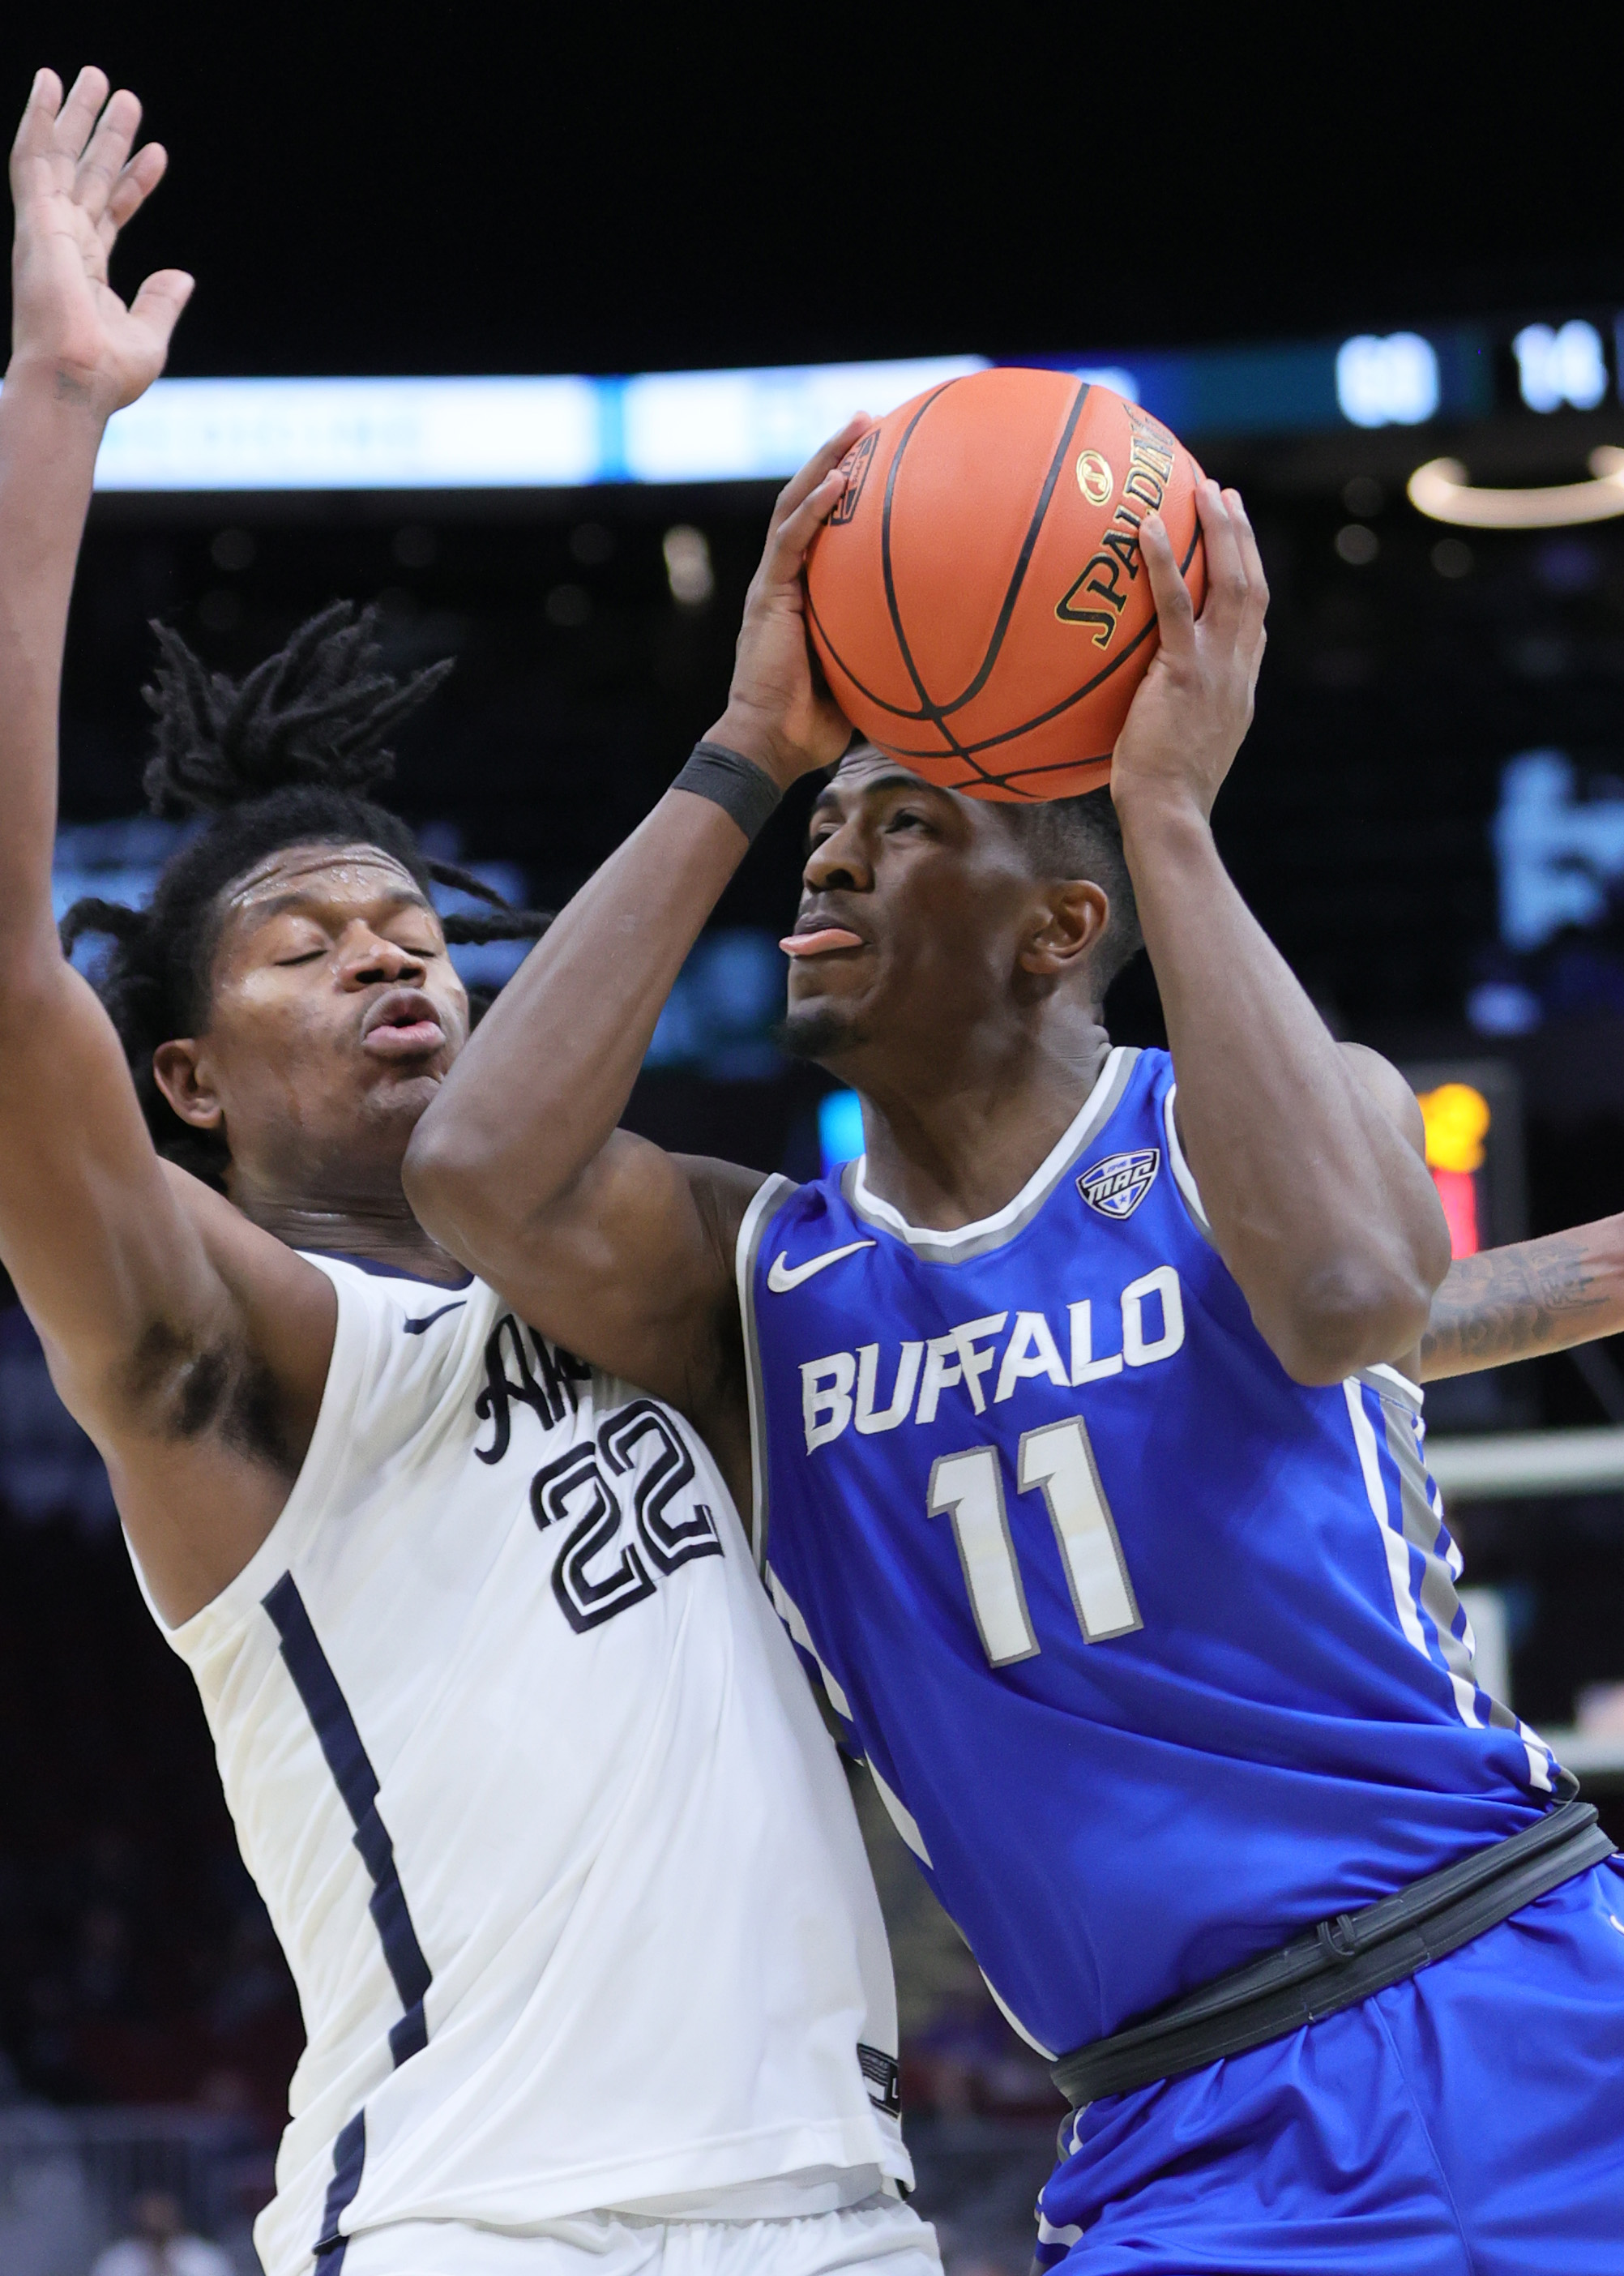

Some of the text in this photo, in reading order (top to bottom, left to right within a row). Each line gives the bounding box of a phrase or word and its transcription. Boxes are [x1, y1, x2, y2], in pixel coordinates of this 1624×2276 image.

[1055, 402, 1176, 651] SPALDING
[1087, 1161, 1154, 1206] MAC
[798, 1264, 1186, 1457] BUFFALO
[529, 1399, 724, 1635] 22
[925, 1414, 1145, 1670] 11
